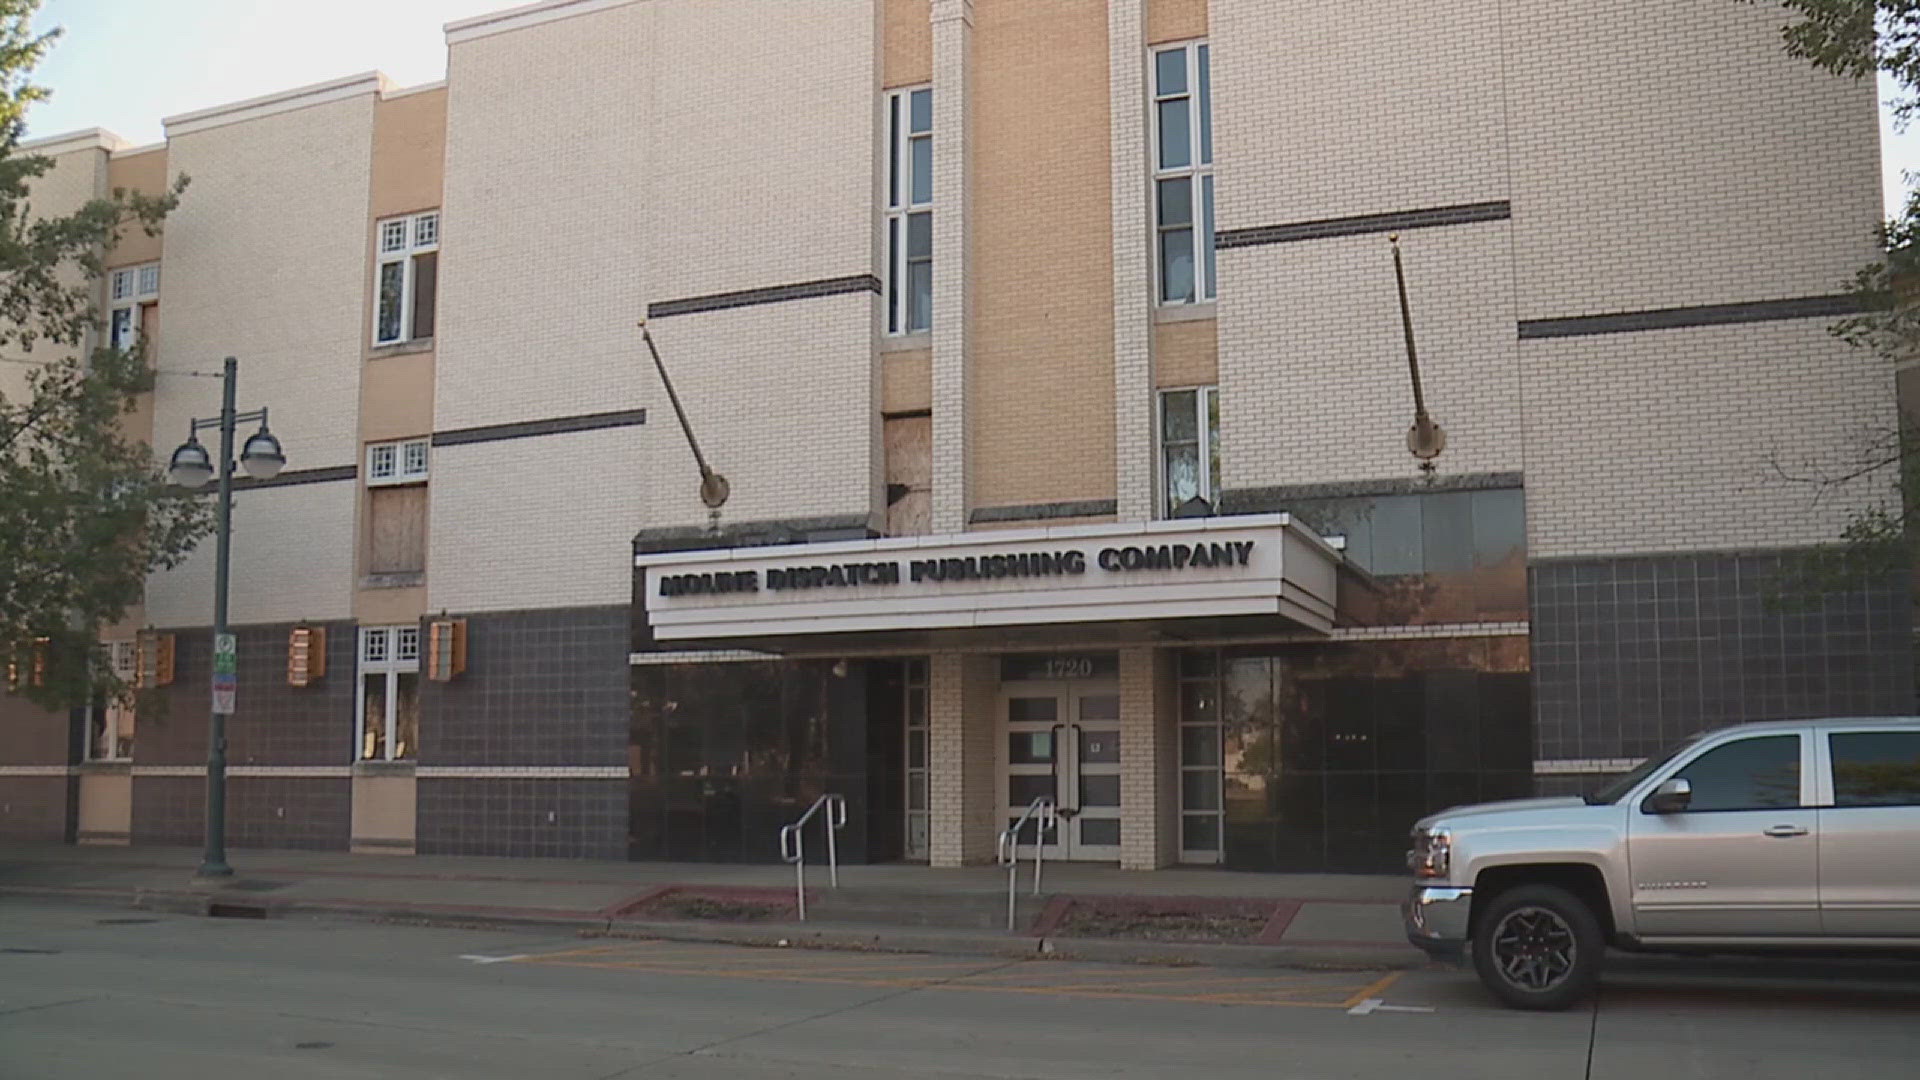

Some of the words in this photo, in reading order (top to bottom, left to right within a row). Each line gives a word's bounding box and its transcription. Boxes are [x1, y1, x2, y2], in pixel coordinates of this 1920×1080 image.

[660, 571, 758, 596] MOLINE
[766, 562, 899, 590] DISPATCH
[911, 550, 1085, 581] PUBLISHING
[1098, 541, 1254, 572] COMPANY
[1046, 660, 1093, 677] 1720
